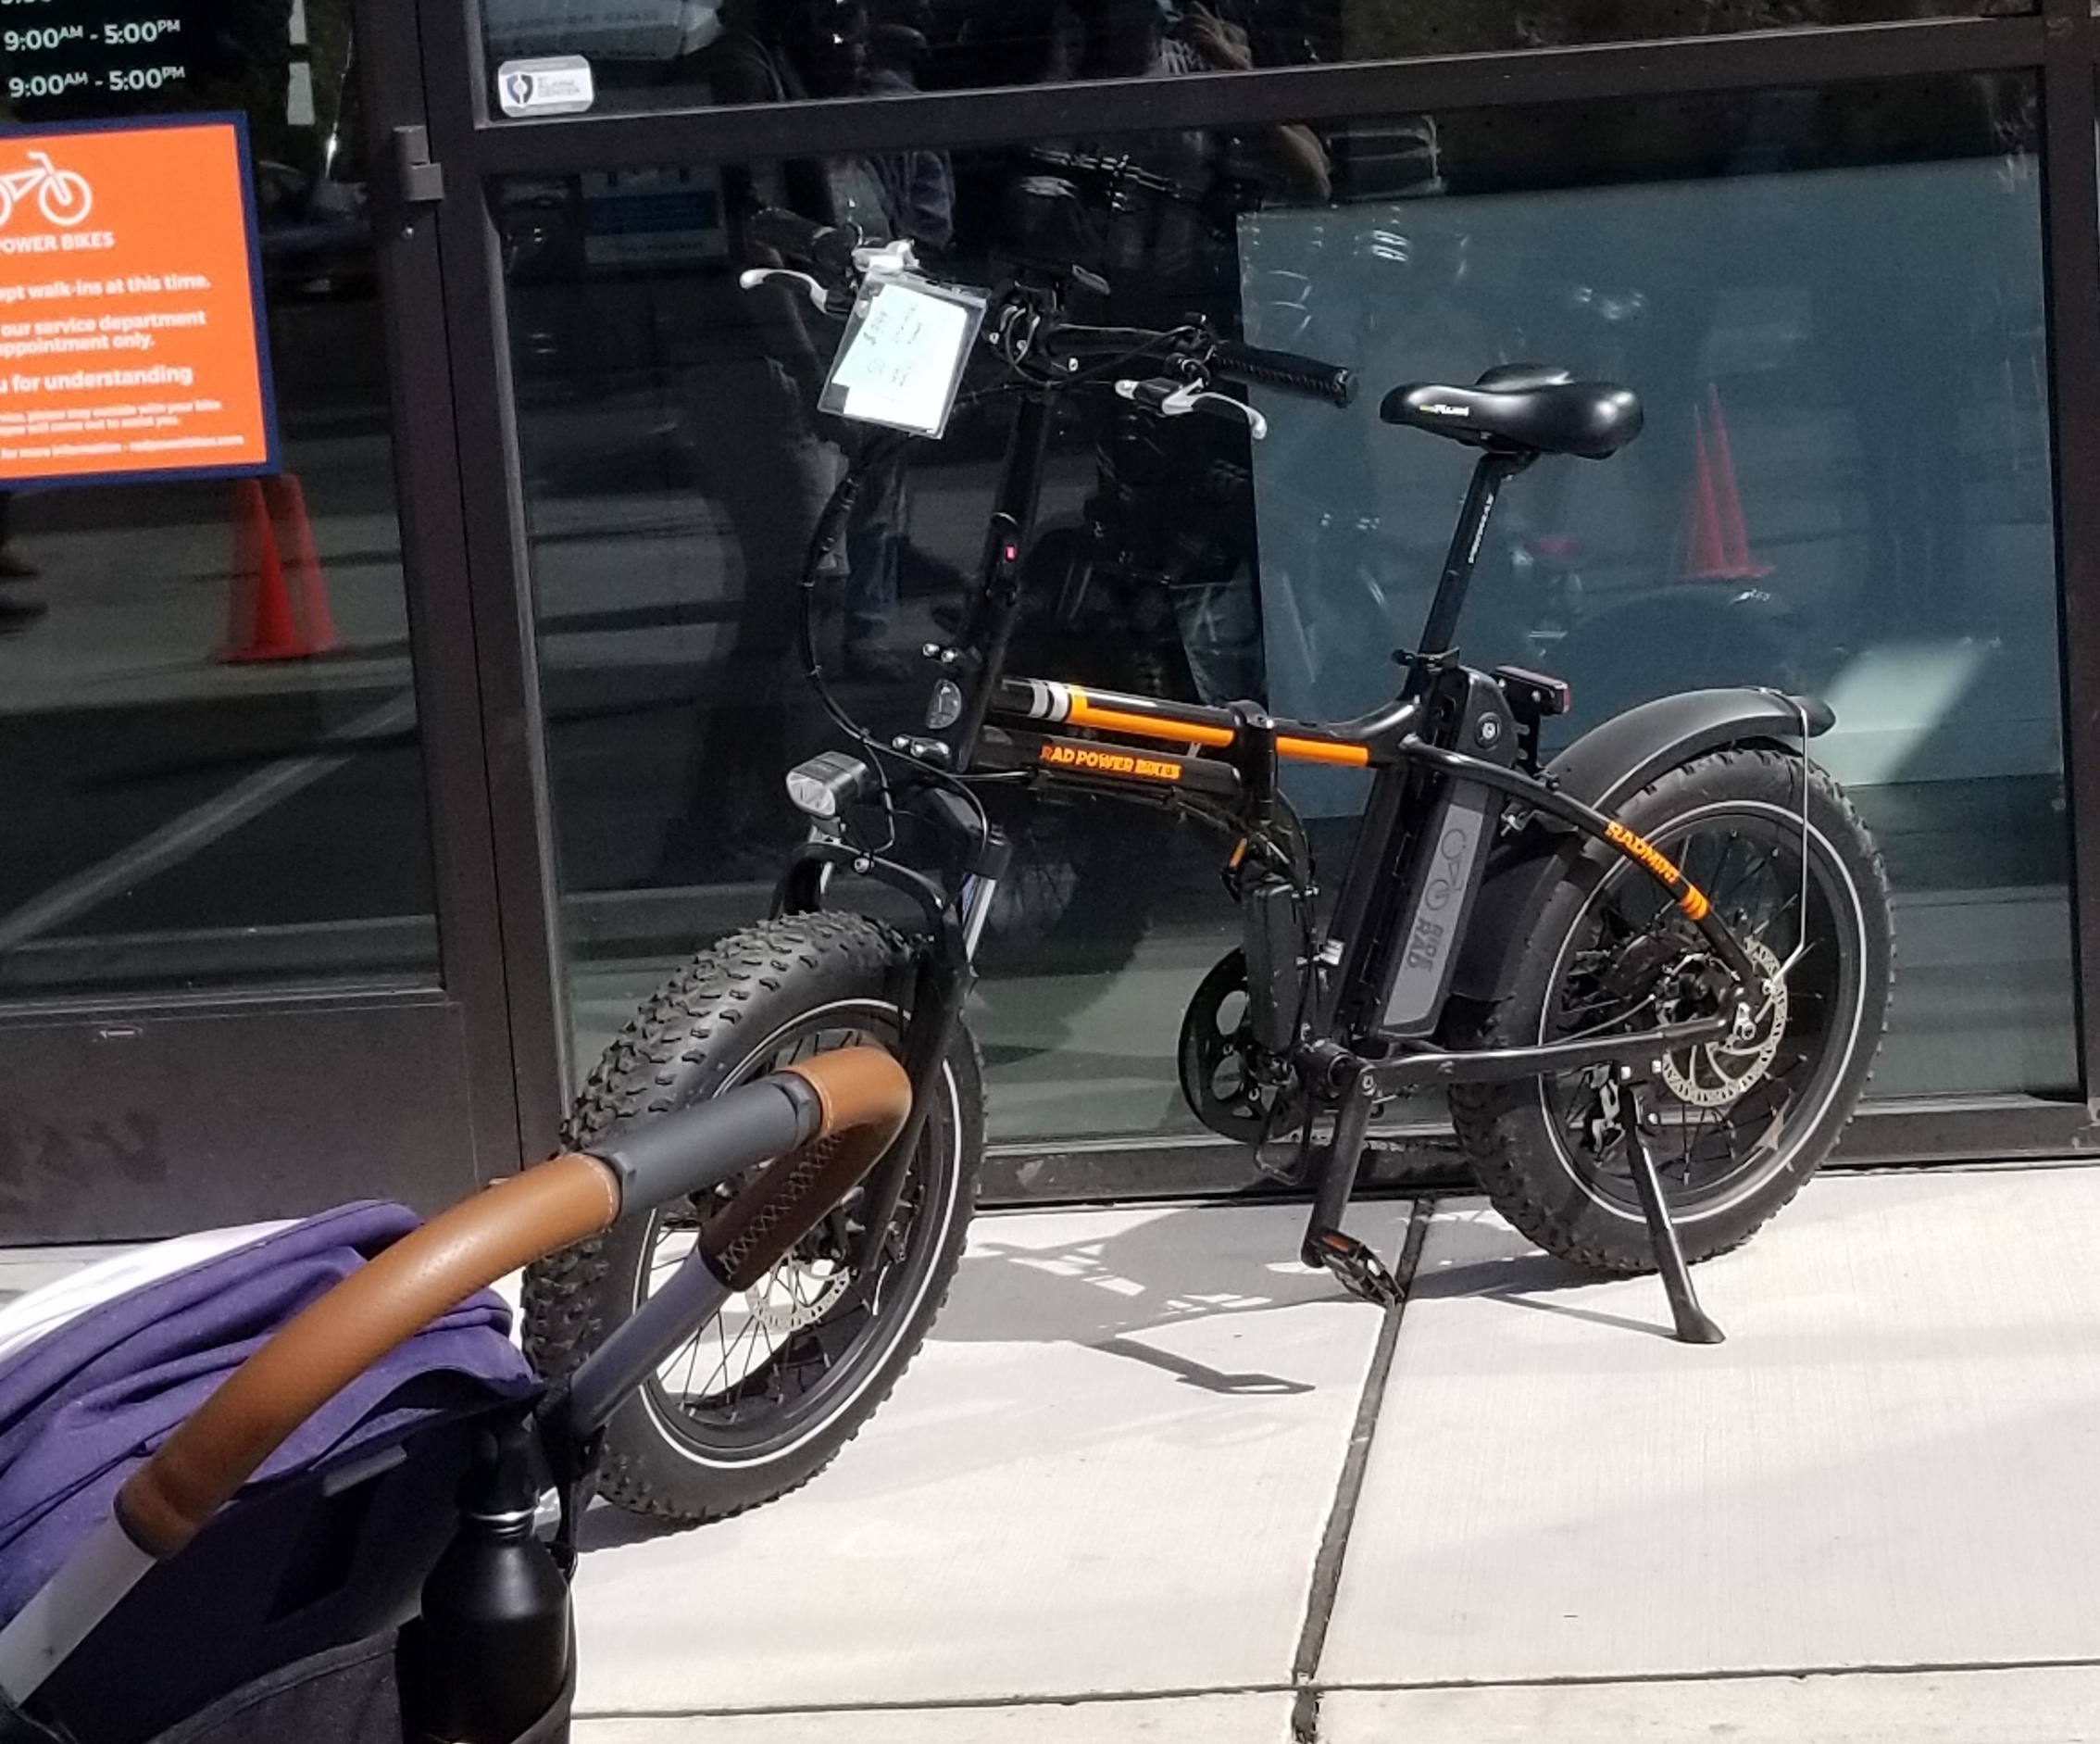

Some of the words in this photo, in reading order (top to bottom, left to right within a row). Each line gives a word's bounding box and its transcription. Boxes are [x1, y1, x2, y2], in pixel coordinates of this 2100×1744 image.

[4, 25, 83, 51] 9:00AM
[104, 19, 181, 44] 5:00PM
[8, 71, 88, 97] 9:00AM
[109, 66, 185, 91] 5:00PM
[0, 234, 56, 254] OWER
[60, 231, 115, 250] BIKES
[28, 279, 103, 298] walk-ins
[106, 279, 124, 295] at
[127, 275, 161, 293] this
[164, 273, 211, 290] time.
[1, 323, 31, 337] our
[34, 317, 95, 334] service
[98, 310, 206, 332] department
[113, 332, 155, 350] only.
[12, 373, 40, 393] for
[44, 365, 193, 391] understanding
[1040, 744, 1075, 763] RAD
[1075, 749, 1134, 772] POWER
[1135, 759, 1181, 780] BIKES
